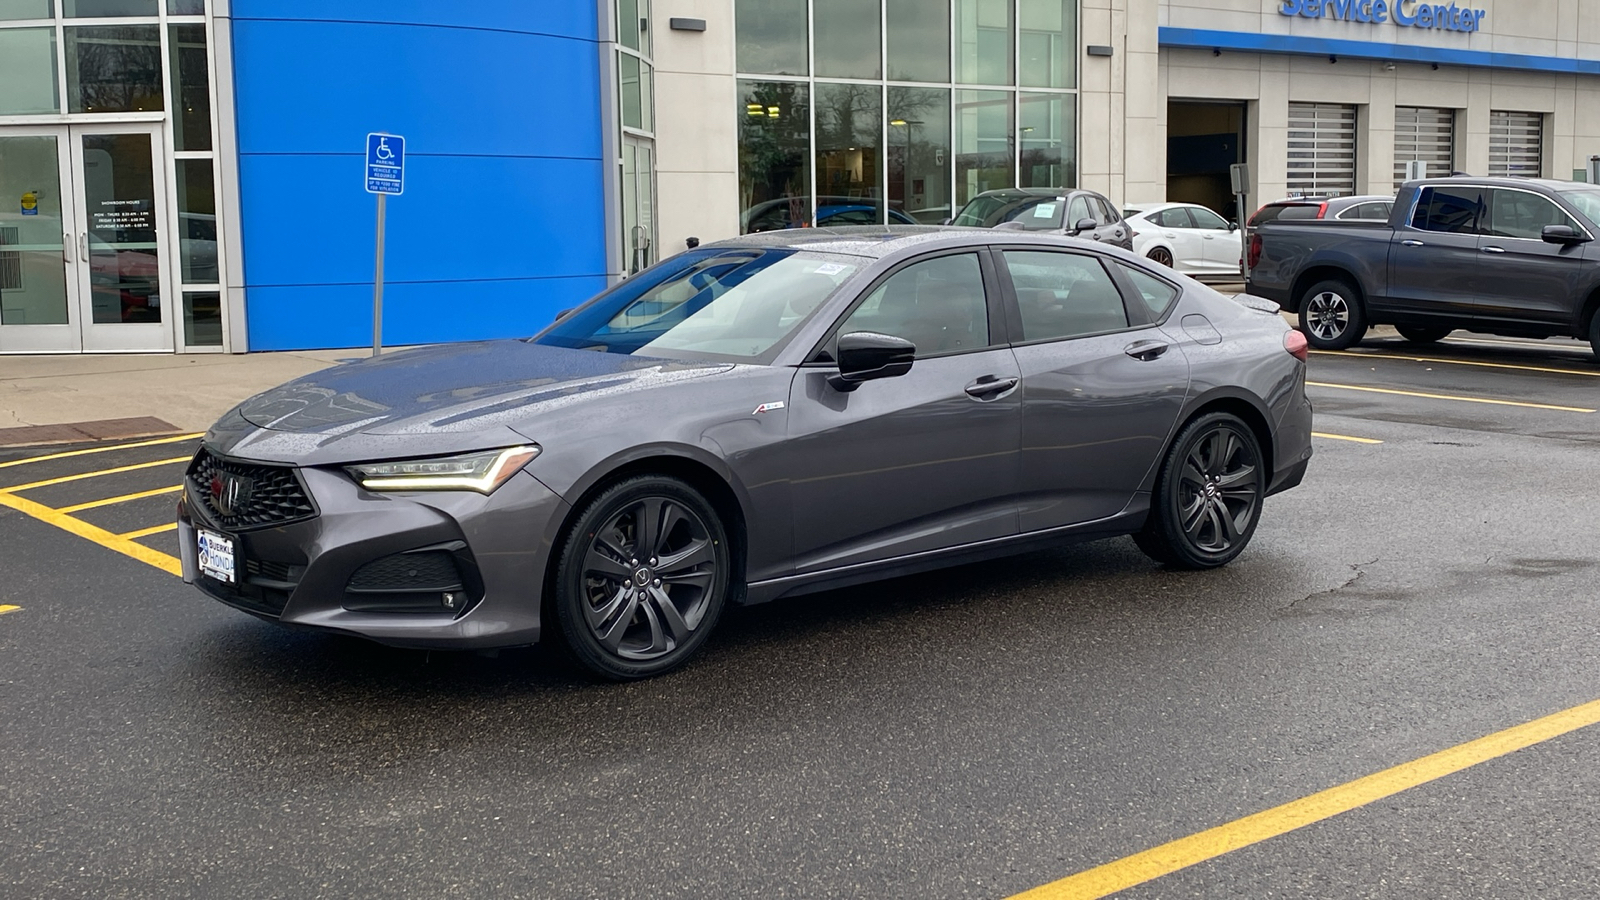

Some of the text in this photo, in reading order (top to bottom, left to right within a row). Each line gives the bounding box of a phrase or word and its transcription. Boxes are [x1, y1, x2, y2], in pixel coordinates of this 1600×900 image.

[1393, 0, 1486, 32] Center
[209, 539, 234, 555] BUERKLE
[210, 550, 234, 570] HONDA
